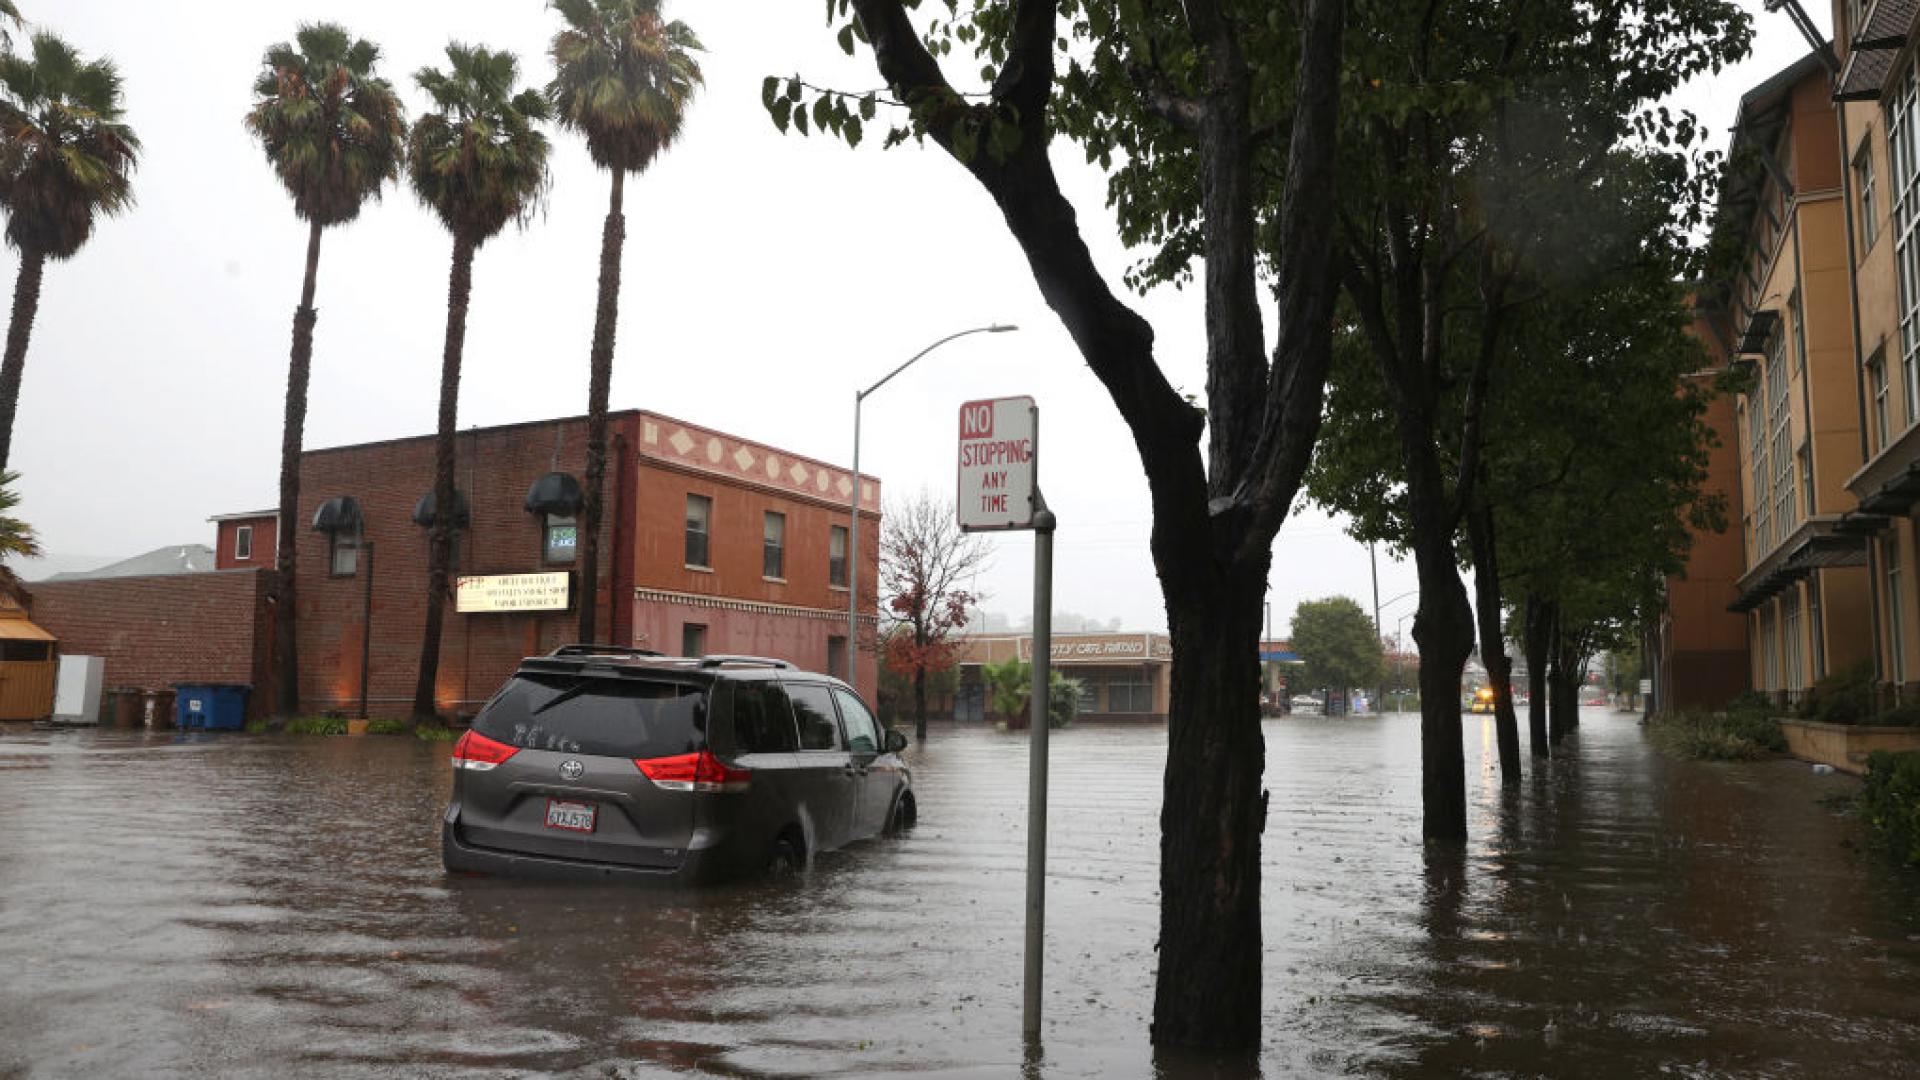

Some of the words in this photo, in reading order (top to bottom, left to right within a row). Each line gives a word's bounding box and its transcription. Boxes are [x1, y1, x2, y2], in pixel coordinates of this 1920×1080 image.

[965, 406, 991, 433] NO
[962, 439, 1031, 467] STOPPING
[982, 471, 1007, 489] ANY
[981, 495, 1008, 513] TIME
